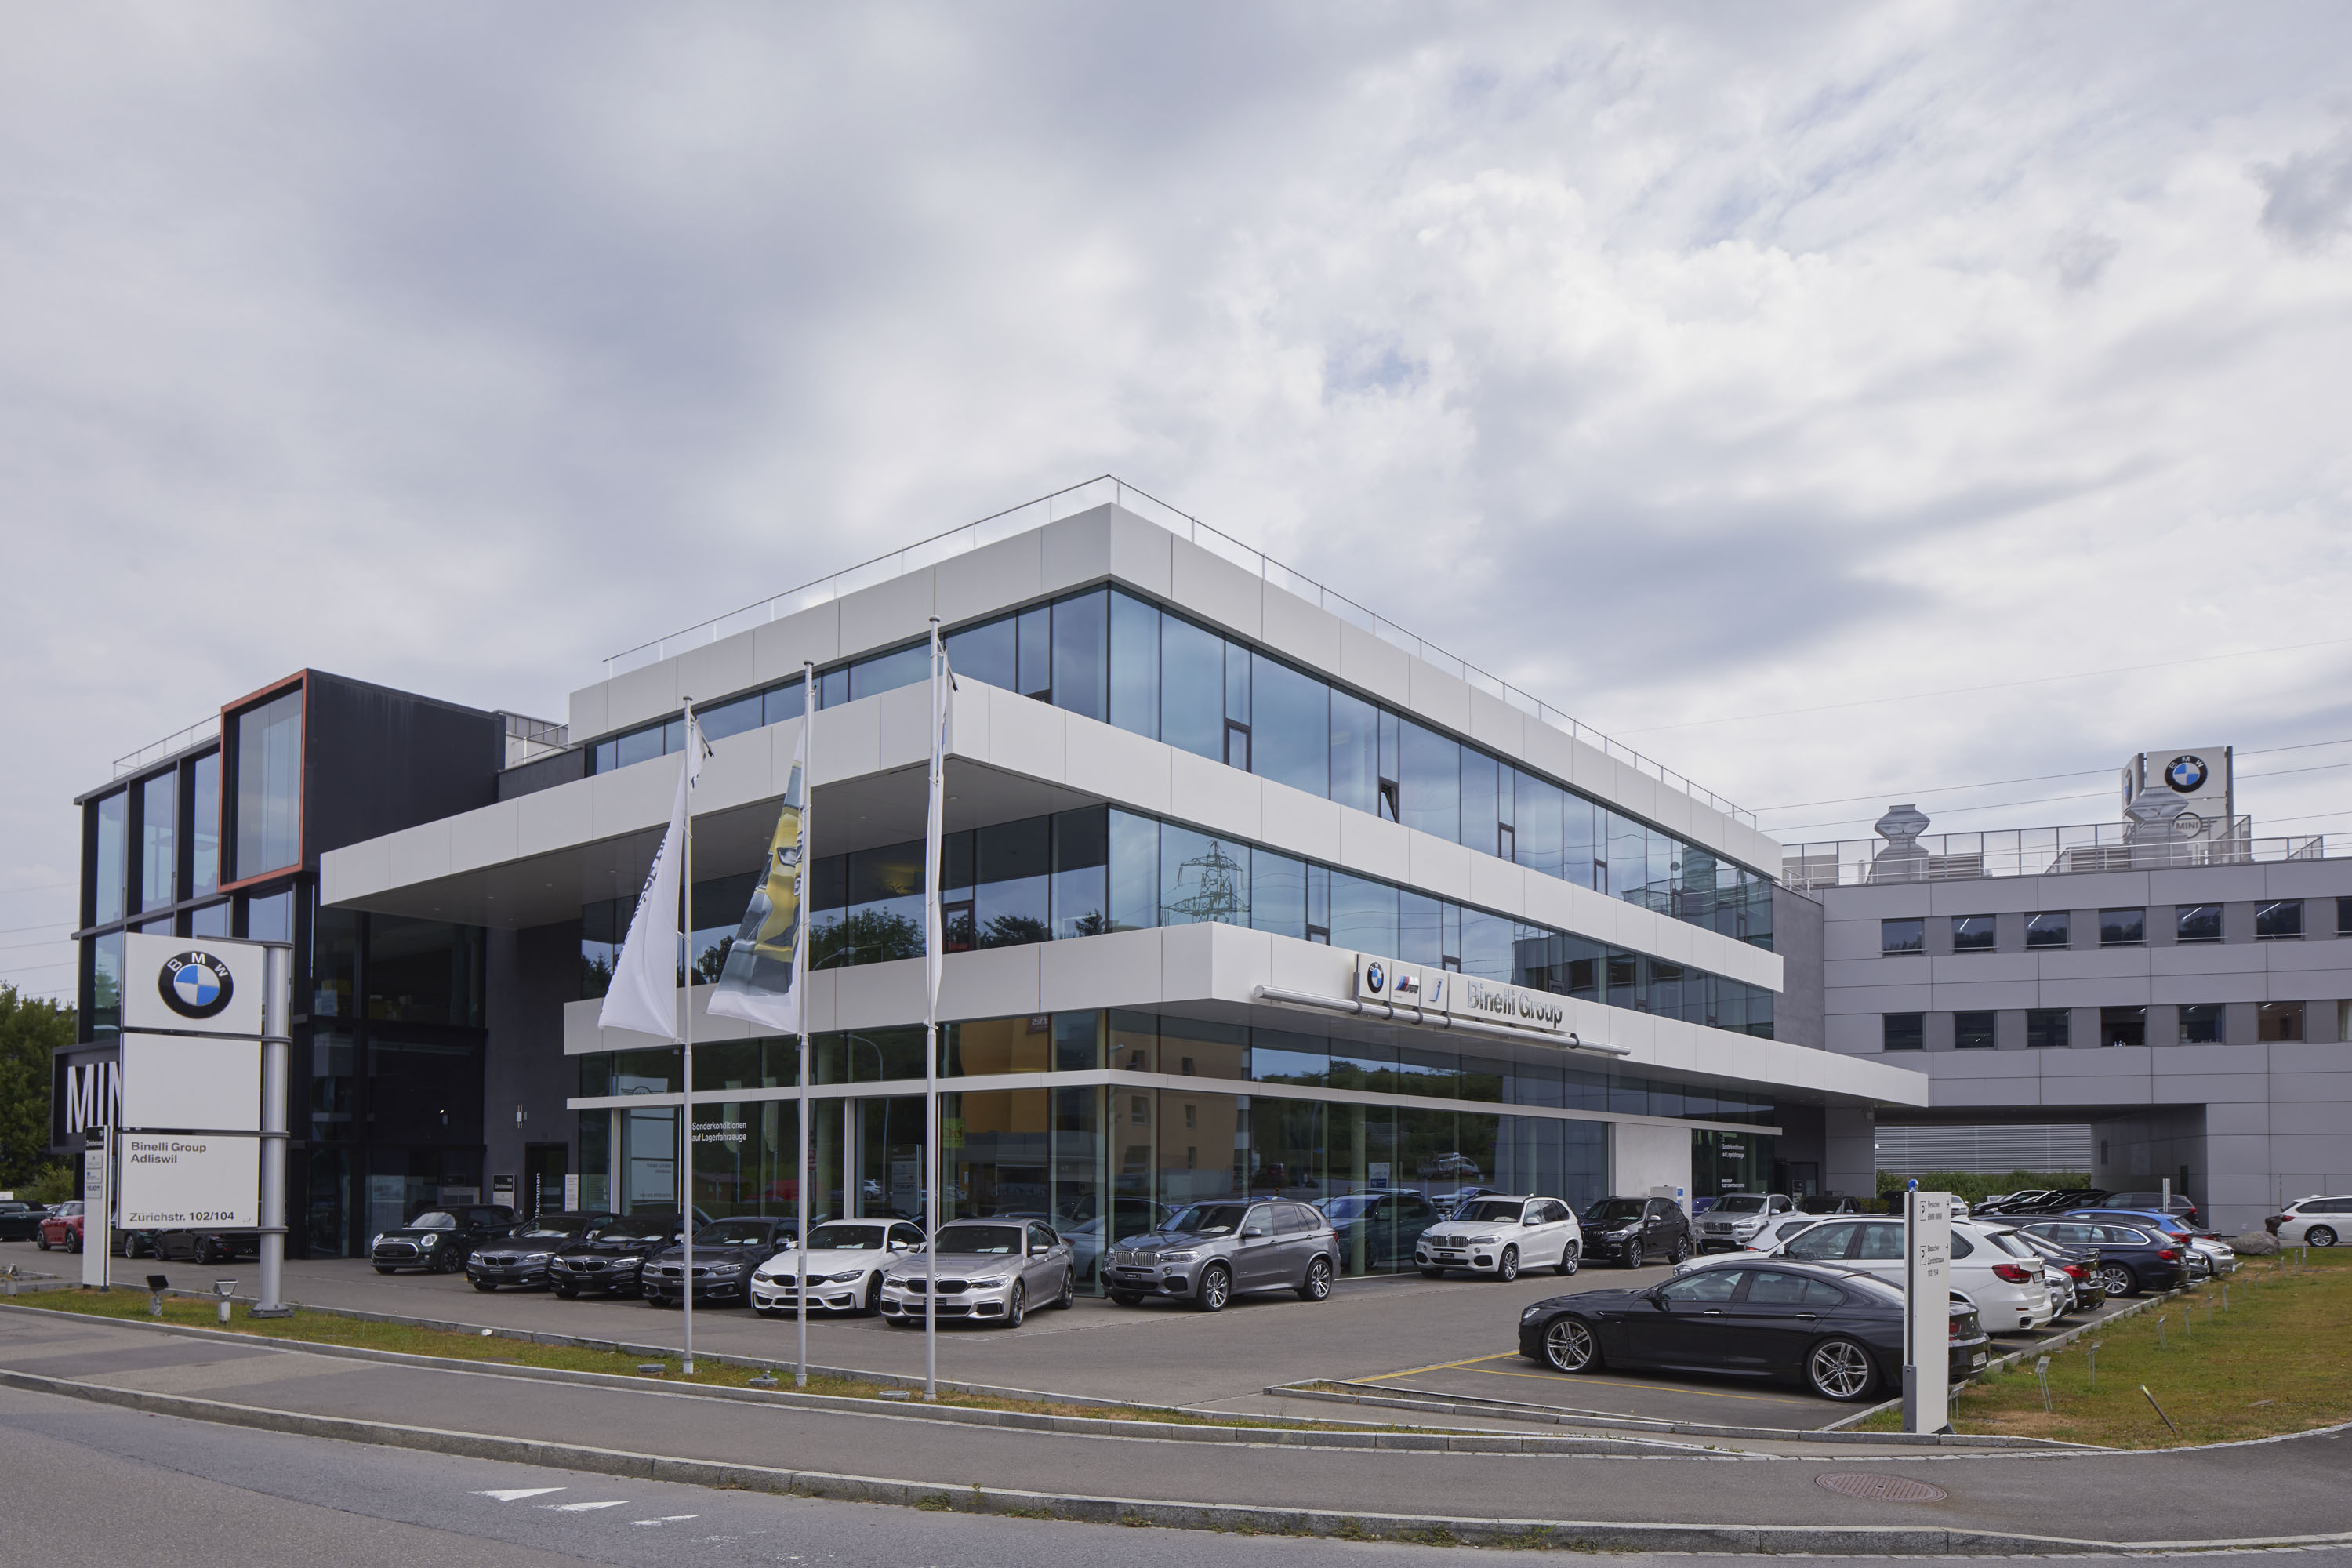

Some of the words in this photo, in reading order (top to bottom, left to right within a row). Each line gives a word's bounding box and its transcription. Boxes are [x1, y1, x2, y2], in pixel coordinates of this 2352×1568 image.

[2169, 757, 2204, 769] BMW
[2176, 821, 2198, 829] MINI
[166, 952, 228, 978] BMW
[1468, 981, 1515, 1015] Binelli
[1519, 990, 1563, 1029] Group
[67, 1061, 122, 1134] MIN
[691, 1121, 747, 1131] Sonderkonditionen
[691, 1133, 701, 1142] auf
[702, 1132, 747, 1143] Lagerfahrzeuge
[131, 1142, 169, 1152] Binelli
[171, 1142, 207, 1154] Group
[130, 1154, 178, 1163] Adliswil
[129, 1212, 186, 1222] Zürichstr.
[189, 1211, 234, 1221] 102/104
